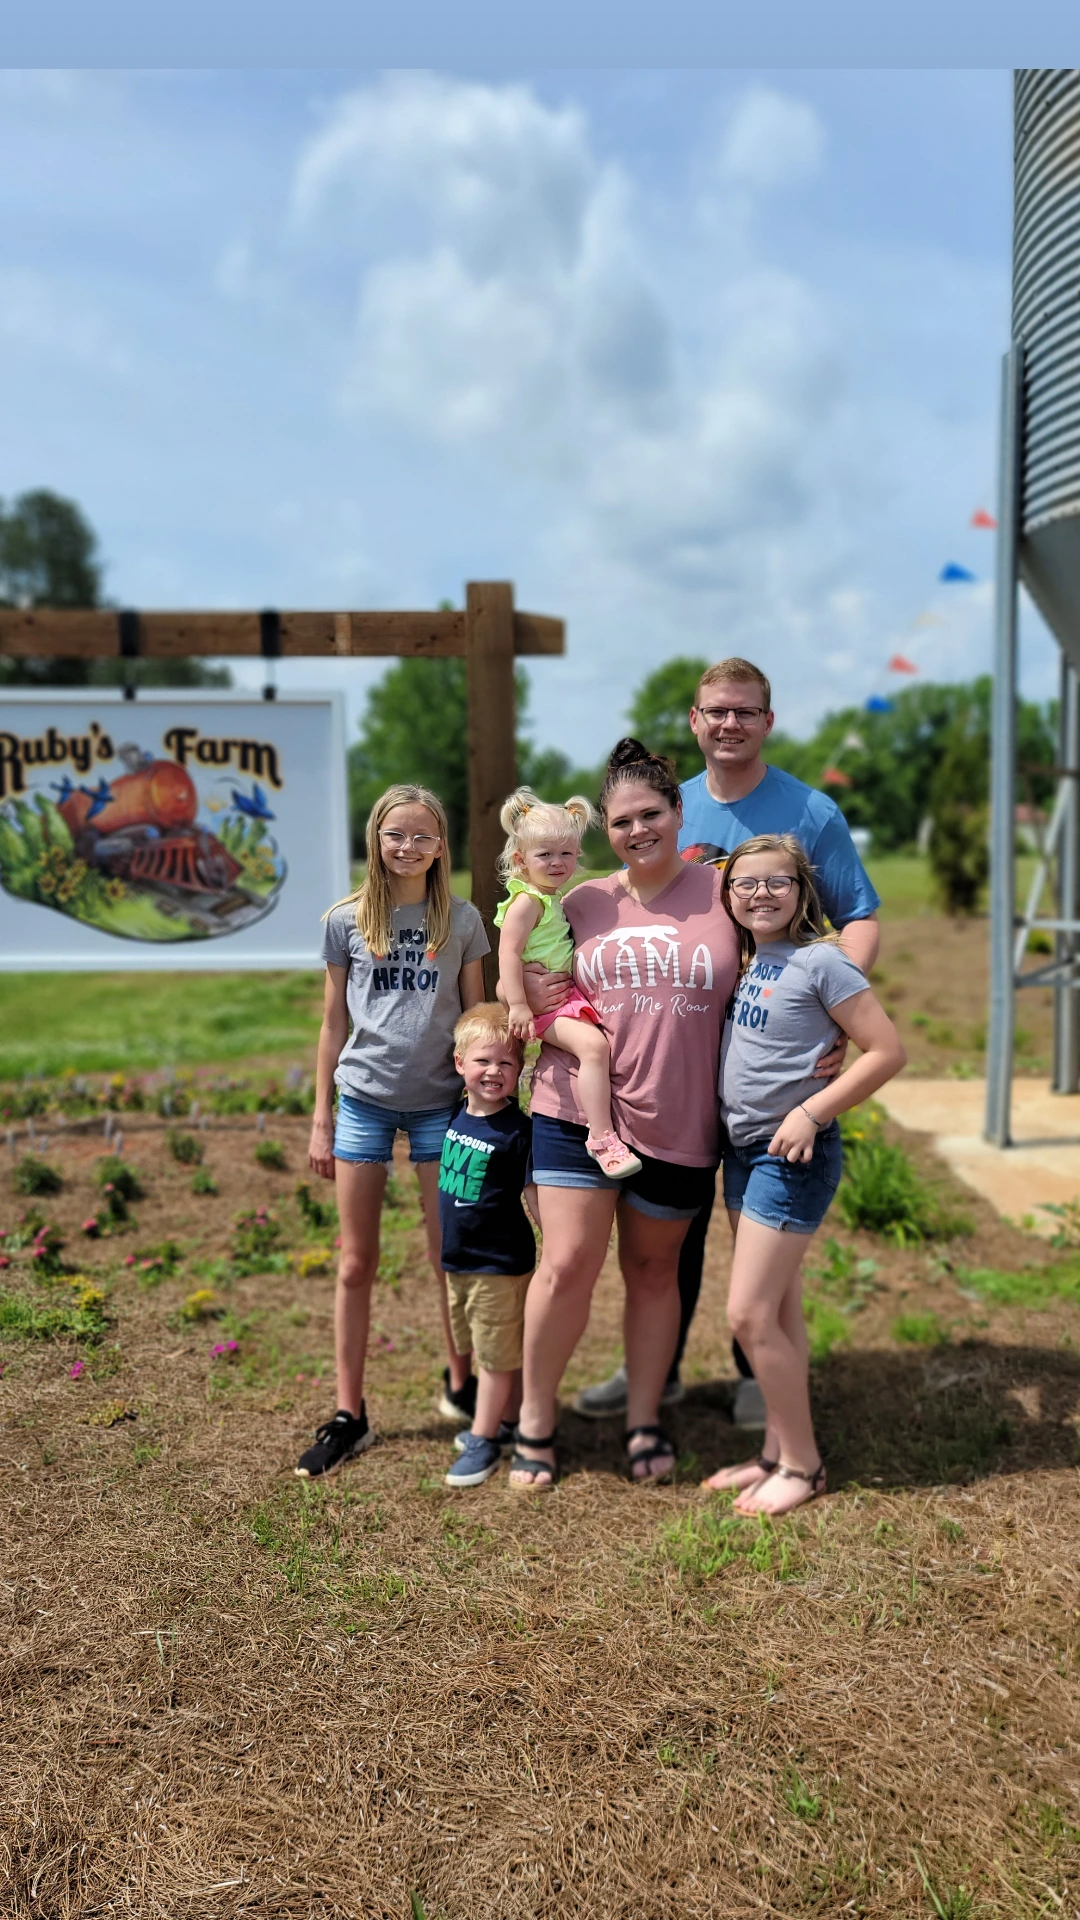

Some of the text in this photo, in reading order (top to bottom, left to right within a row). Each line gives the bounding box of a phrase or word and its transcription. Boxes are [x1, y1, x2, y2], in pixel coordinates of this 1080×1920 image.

[0, 721, 282, 798] Ruby's Farm
[387, 950, 424, 966] IS MY
[575, 942, 713, 995] MAMA
[373, 967, 438, 993] HERO!
[750, 962, 784, 981] MOM
[595, 992, 710, 1017] Hear Me Roar
[748, 984, 762, 1001] MY
